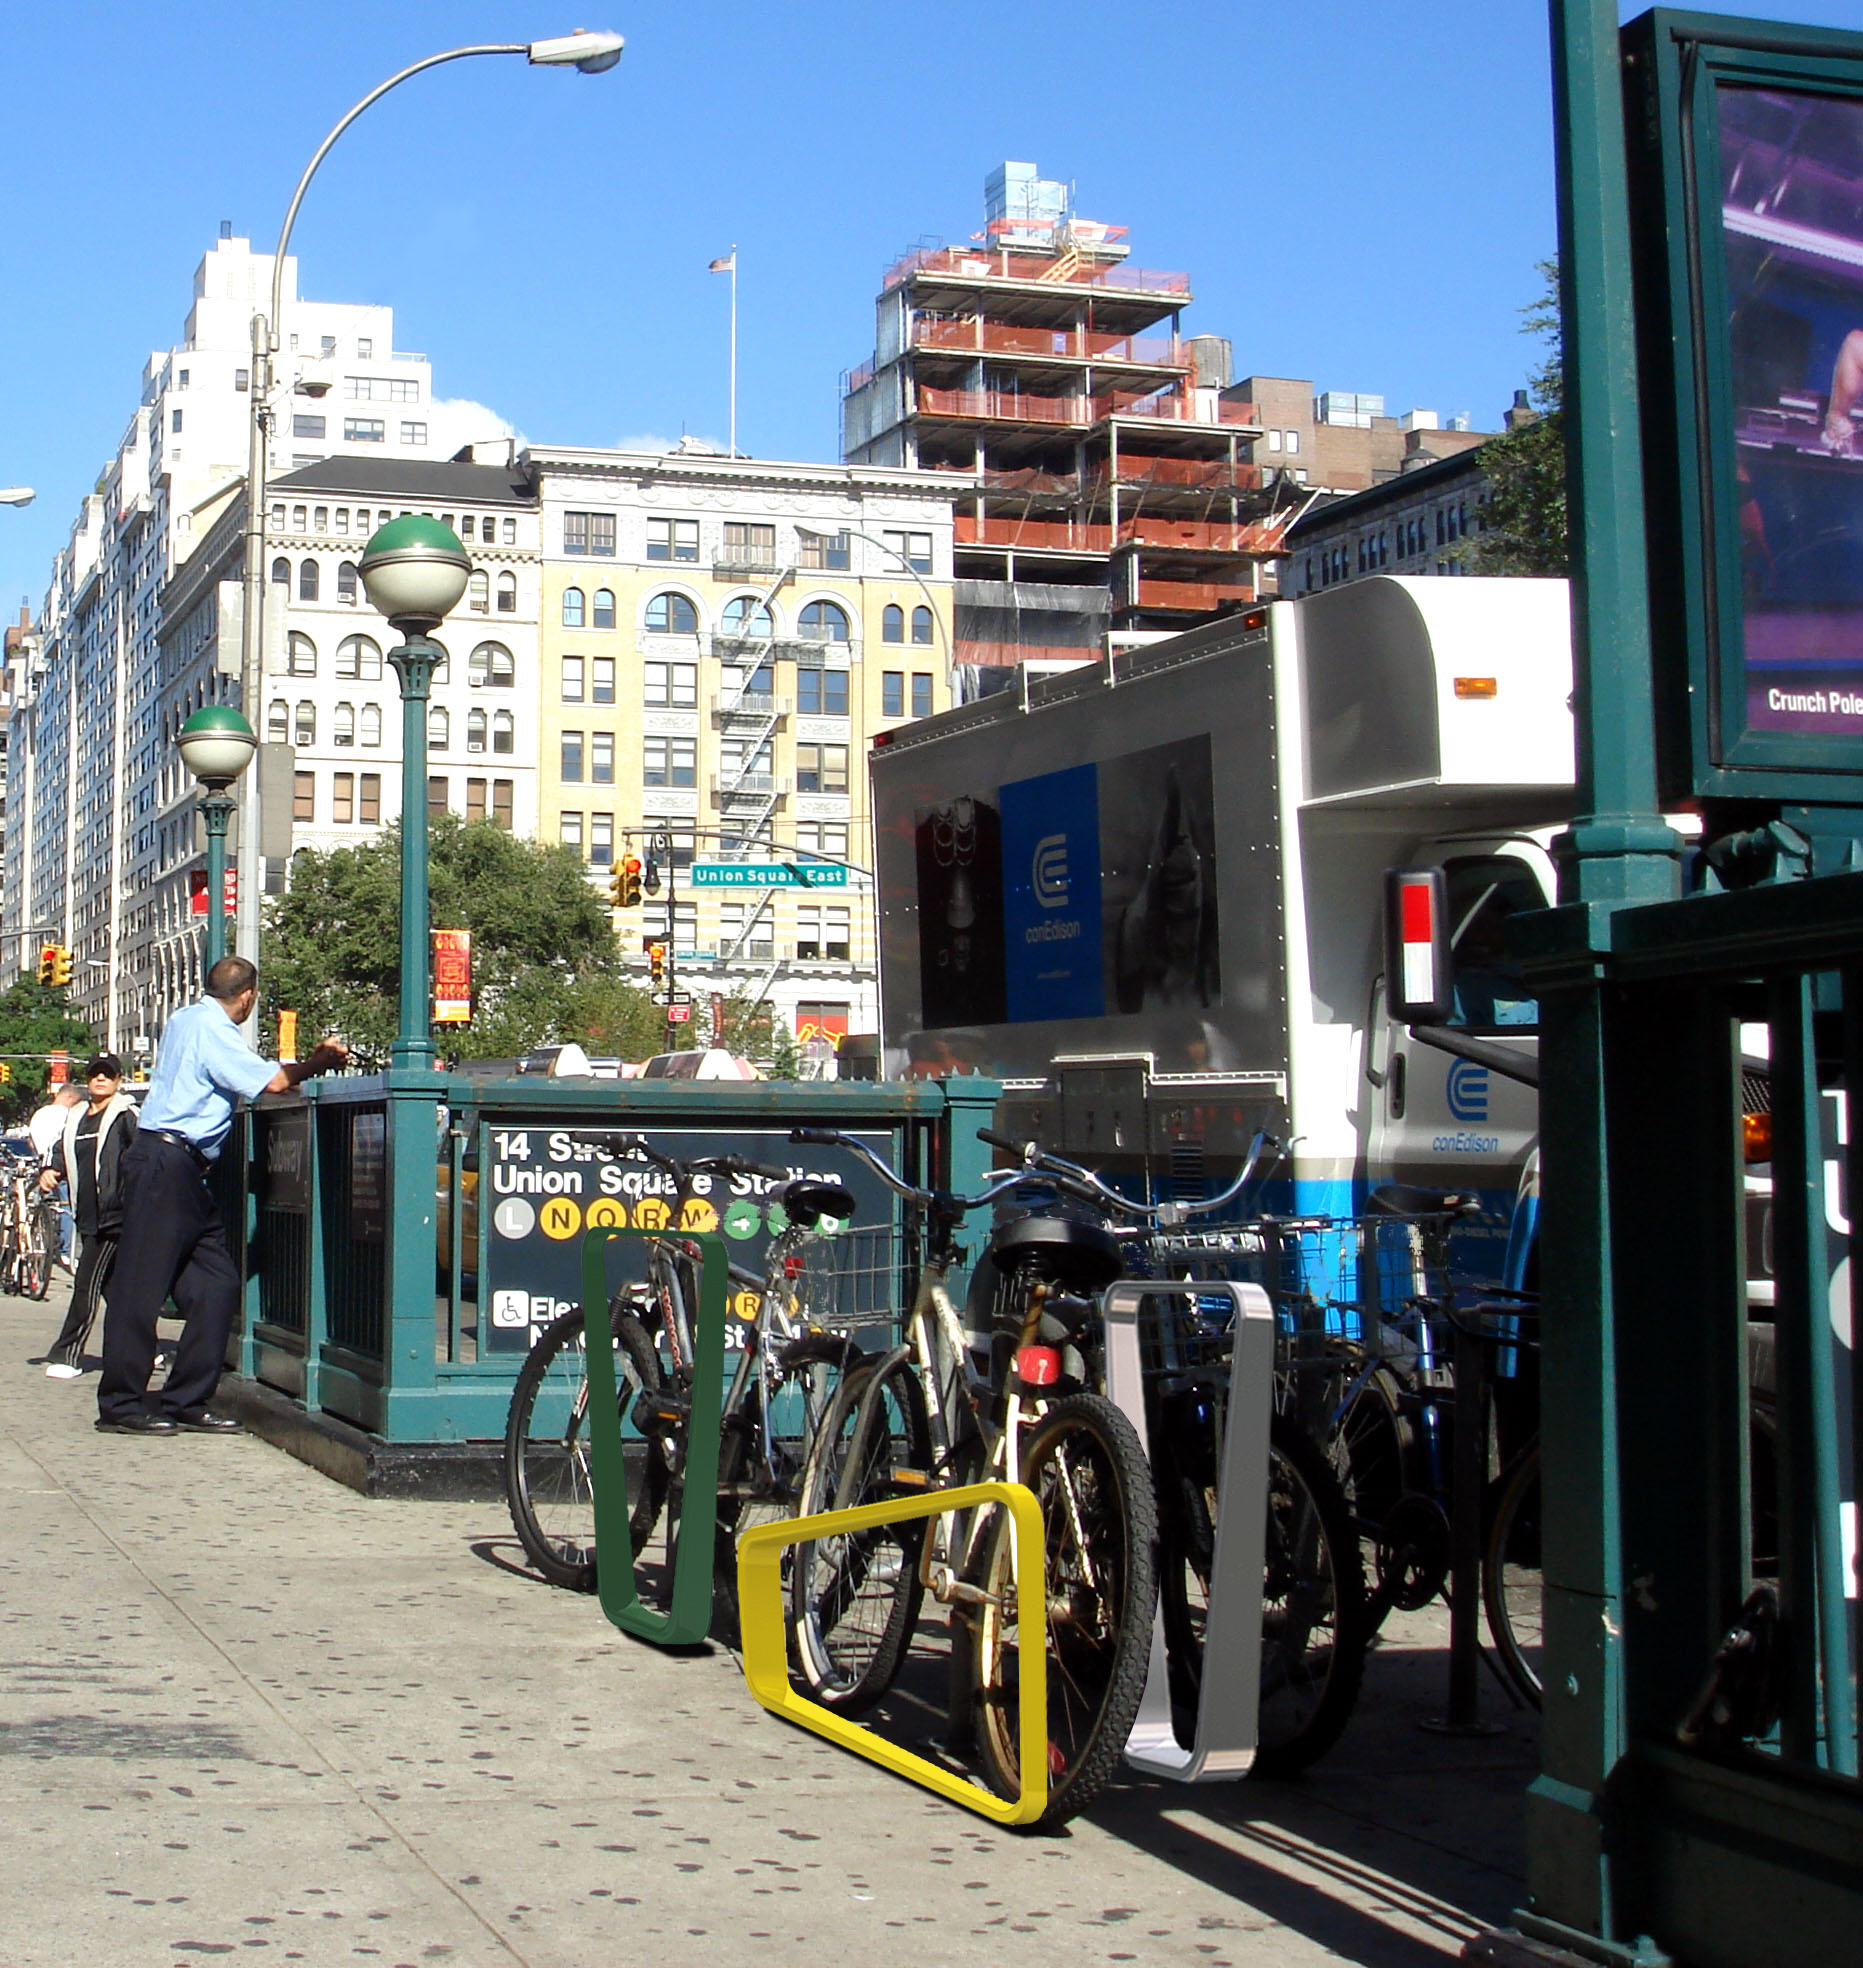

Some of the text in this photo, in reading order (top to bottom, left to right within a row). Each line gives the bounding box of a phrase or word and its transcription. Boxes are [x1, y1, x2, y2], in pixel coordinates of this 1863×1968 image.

[1768, 688, 1827, 713] Crunch
[697, 870, 843, 884] Union Squar East
[1026, 920, 1080, 943] conEdison
[494, 1132, 531, 1161] 14
[1432, 1132, 1499, 1152] conEdison
[493, 1164, 582, 1194] Union
[600, 1165, 713, 1200] Squae
[505, 1206, 523, 1230] L
[551, 1207, 570, 1229] N
[596, 1207, 616, 1227] Q
[643, 1208, 661, 1230] R
